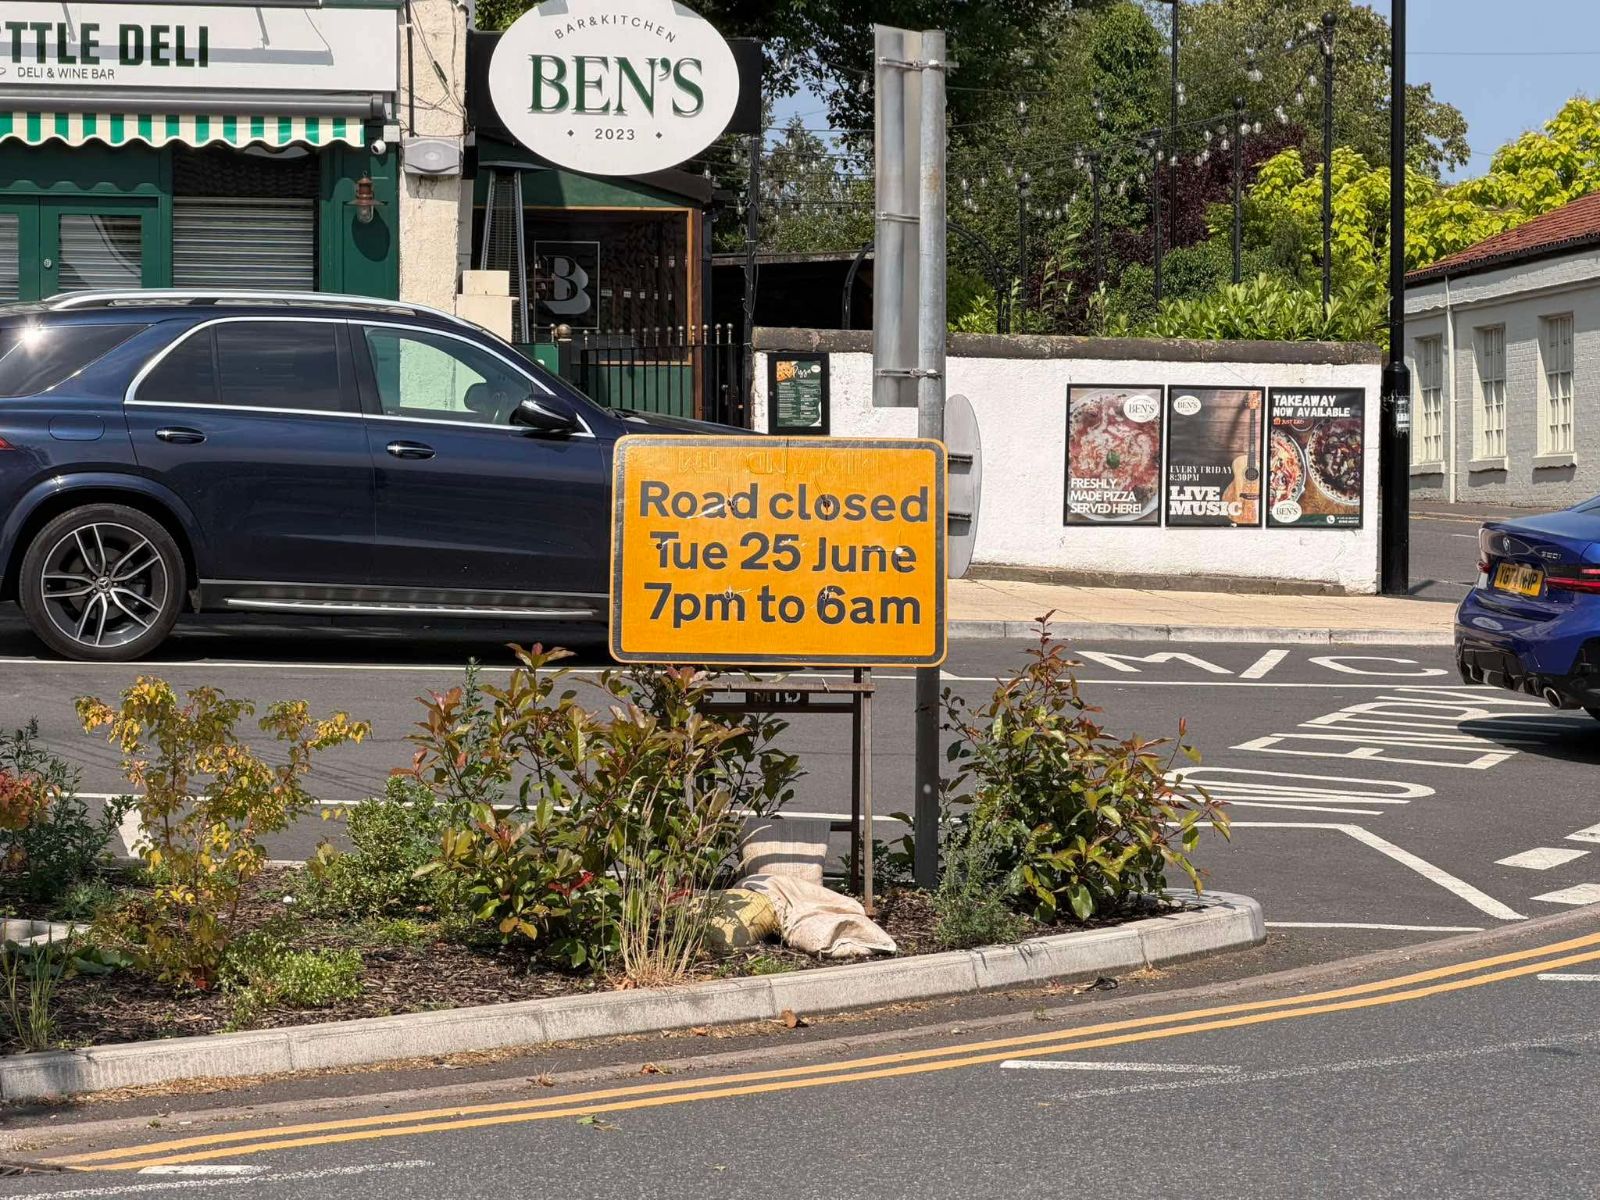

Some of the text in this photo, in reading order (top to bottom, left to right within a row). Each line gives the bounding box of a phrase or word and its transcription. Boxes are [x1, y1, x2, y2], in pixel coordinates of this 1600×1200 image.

[554, 14, 676, 43] BAR&KITCHEN
[0, 21, 208, 68] TTLE DELI
[17, 67, 115, 80] DELI & WINE BAR
[528, 54, 704, 118] BEN'S
[594, 128, 635, 140] 2023
[543, 255, 591, 315] B
[1273, 395, 1337, 407] TAKEAWAY
[1273, 407, 1351, 417] NOW AVAILABLE
[1170, 465, 1233, 475] EVERY FRIDAY
[1070, 478, 1118, 489] FRESHLY
[1070, 490, 1137, 502] MADE PIZZA
[1169, 486, 1220, 500] LIVE
[639, 481, 928, 523] Road closed
[1070, 502, 1142, 514] SERVED HERE!
[1169, 501, 1244, 516] MUSIC
[650, 531, 917, 573] Tue 25 June
[644, 582, 921, 629] 7pm to 6am
